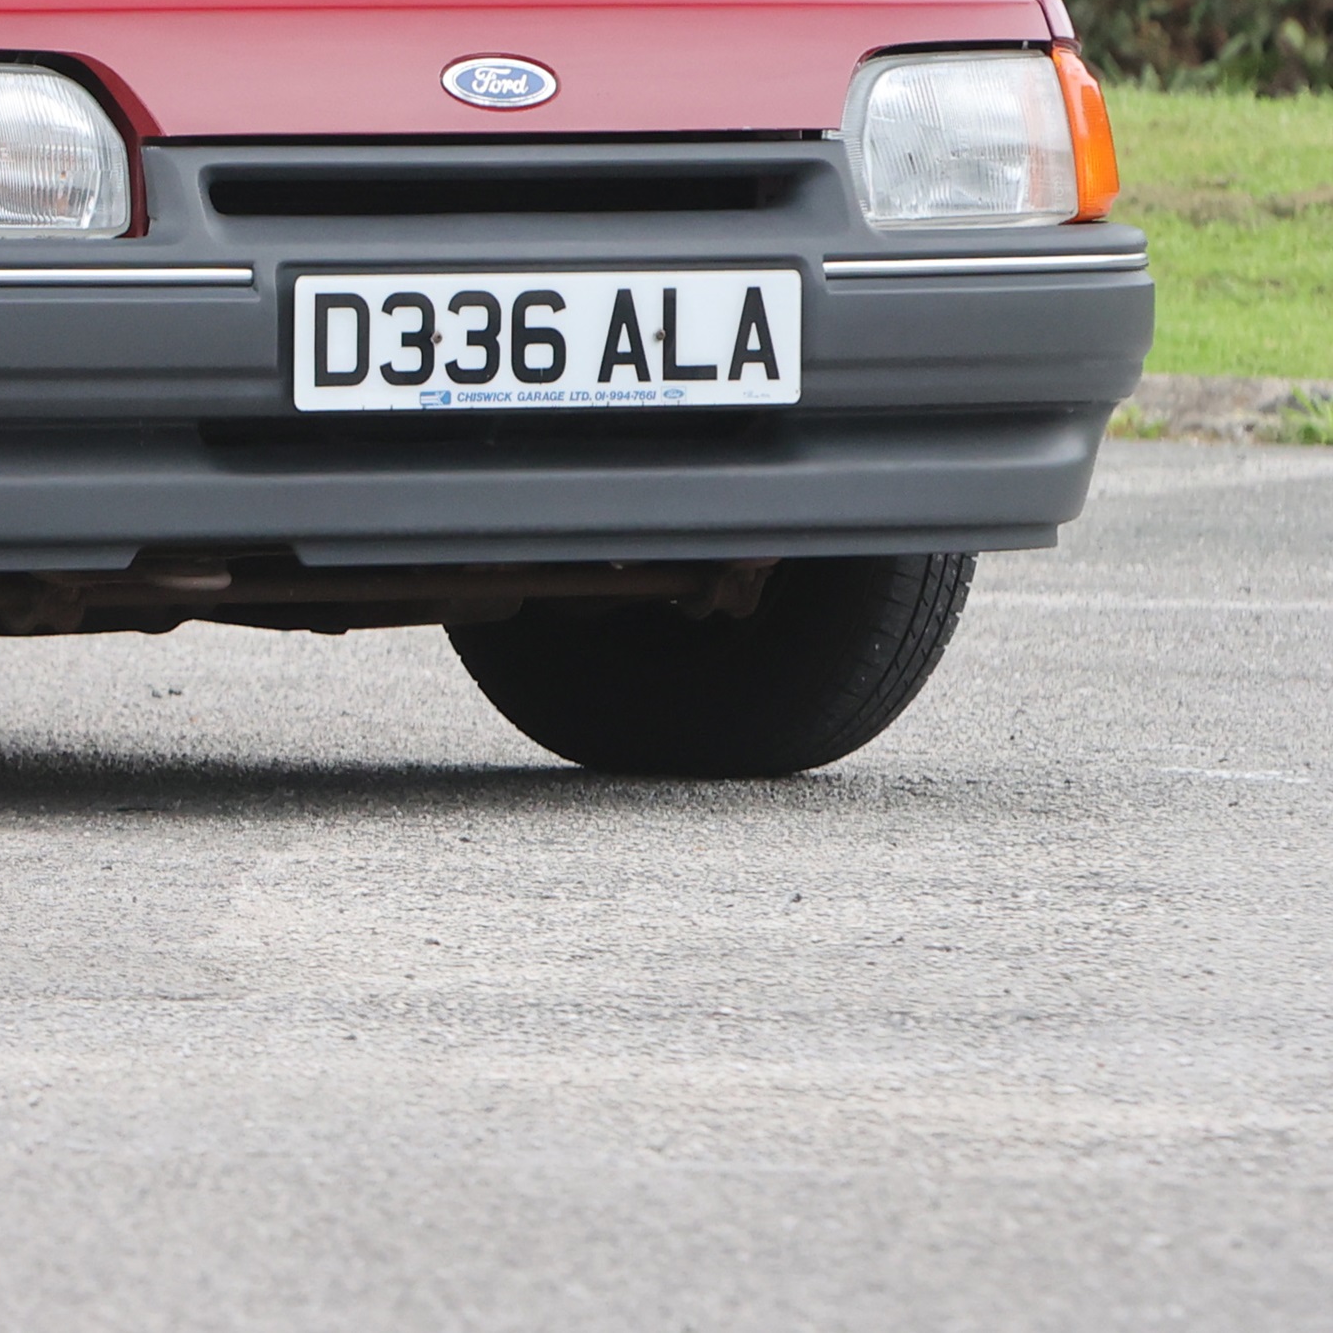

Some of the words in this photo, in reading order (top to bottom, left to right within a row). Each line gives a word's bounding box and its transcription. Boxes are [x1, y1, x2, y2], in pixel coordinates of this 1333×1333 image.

[472, 67, 529, 94] Ford
[314, 289, 567, 387] D336
[597, 286, 781, 383] ALA
[457, 391, 513, 402] CHISWICK
[517, 390, 565, 402] GARAGE
[569, 390, 592, 401] LTD.
